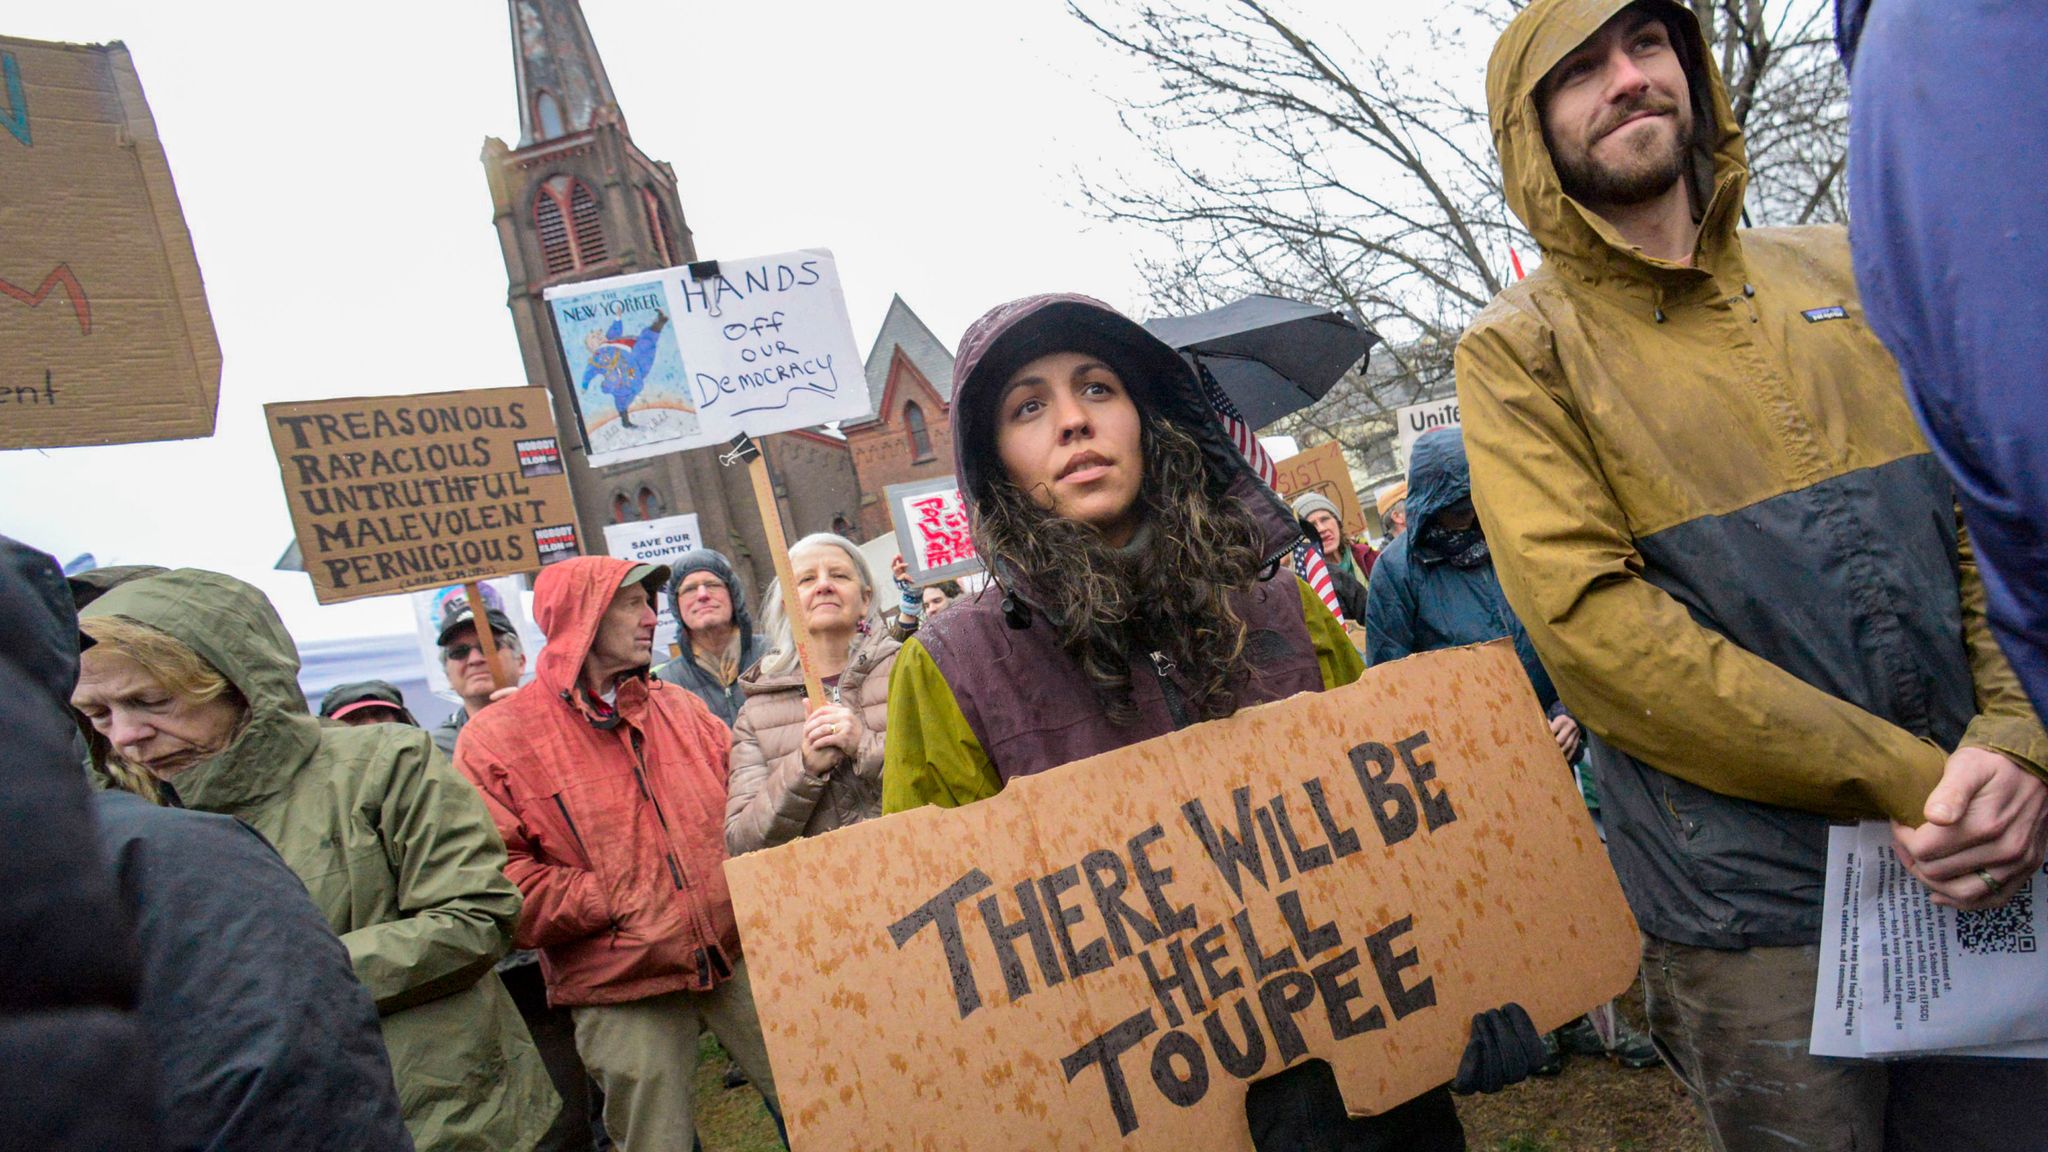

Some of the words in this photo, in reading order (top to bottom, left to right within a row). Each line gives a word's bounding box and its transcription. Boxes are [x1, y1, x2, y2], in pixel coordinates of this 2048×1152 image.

[681, 261, 820, 312] HANDS
[562, 303, 598, 324] NEW
[599, 293, 661, 317] YORKER
[741, 341, 799, 362] OUR
[276, 402, 527, 450] TREASONOUS
[290, 436, 491, 485] RAPACIOUS
[299, 471, 530, 517] UNTRUTHFUL
[311, 500, 547, 553] MALEVOLENT
[631, 535, 662, 550] SAVE
[665, 533, 690, 544] OUR
[636, 543, 693, 560] COUNTRY
[322, 535, 524, 589] PERNICIOUS
[885, 822, 1198, 1020] THERE
[1179, 775, 1363, 904] WILL
[1347, 730, 1458, 847] BE
[1900, 879, 1908, 895] Food
[1912, 897, 1920, 907] for
[1901, 898, 1910, 938] Purchasing
[1914, 910, 1924, 937] Schools
[1927, 922, 1935, 941] Farm
[1840, 949, 1848, 962] and
[1850, 944, 1860, 962] keep
[1881, 943, 1890, 956] and
[1892, 937, 1901, 955] keep
[1917, 940, 1925, 953] and
[1940, 930, 1950, 981] reinstatement
[1137, 889, 1344, 1028] HELL
[1894, 957, 1903, 974] local
[1905, 940, 1913, 979] Assistance
[1918, 955, 1927, 974] Child
[1930, 952, 1940, 977] School
[1850, 963, 1859, 981] local
[1848, 982, 1858, 998] food
[1895, 976, 1903, 992] food
[1906, 980, 1916, 1003] (LFPA)
[1919, 975, 1927, 992] Care
[1932, 978, 1940, 999] Grant
[1845, 1000, 1855, 1027] growing
[1894, 993, 1904, 1021] growing
[1060, 913, 1438, 1138] TOUPEE
